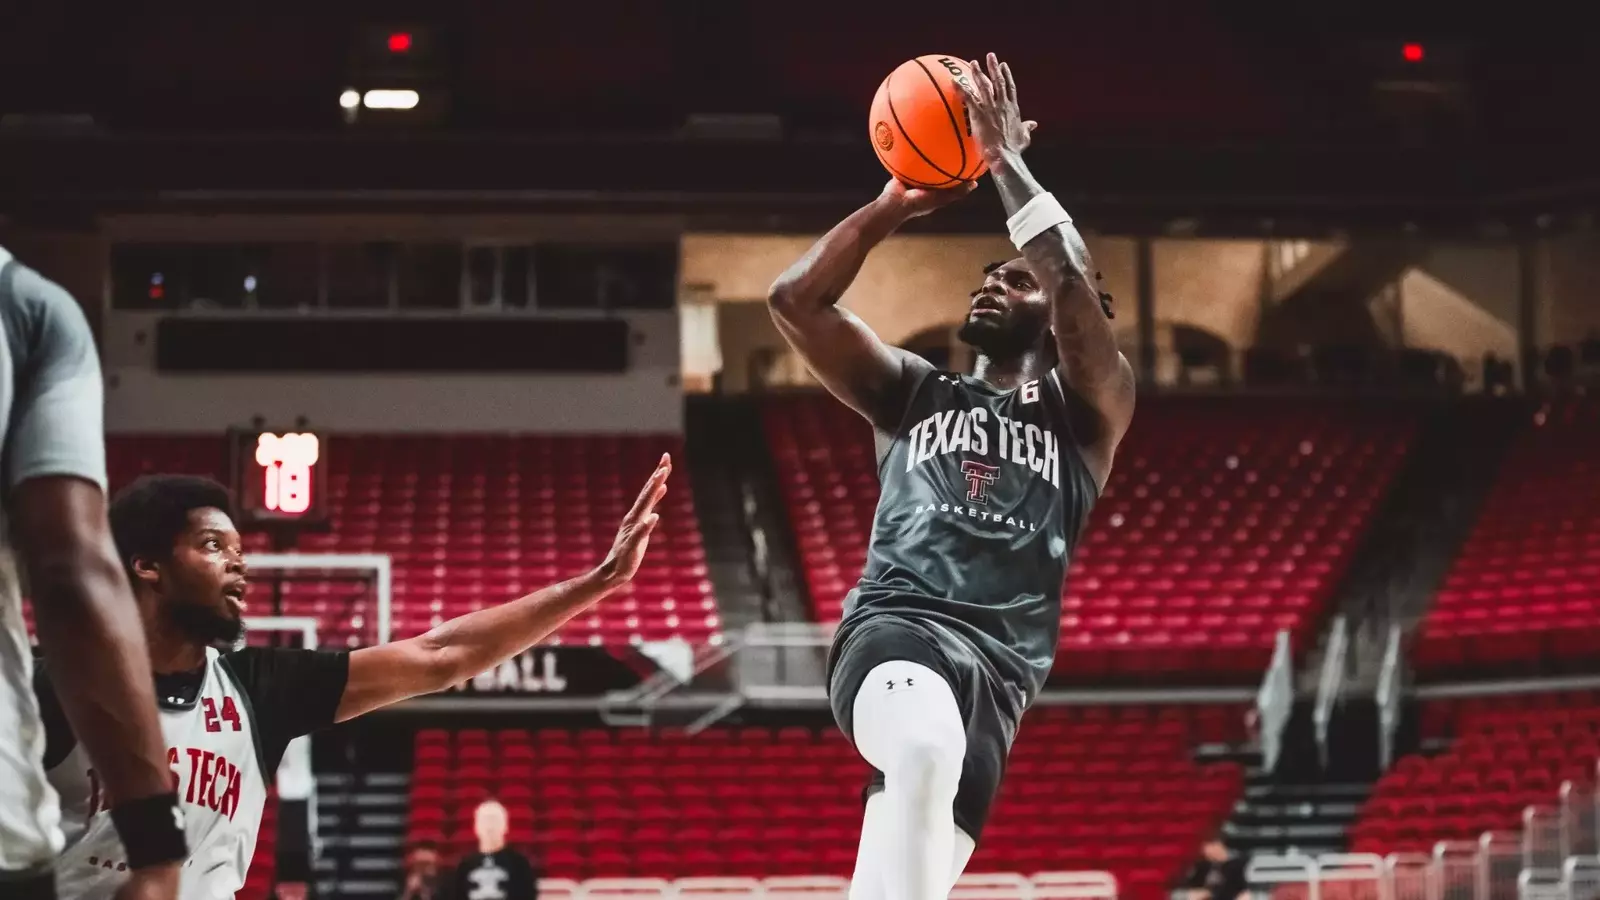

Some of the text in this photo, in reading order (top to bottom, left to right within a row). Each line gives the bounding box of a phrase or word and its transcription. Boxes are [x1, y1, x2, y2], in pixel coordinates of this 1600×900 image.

[1021, 379, 1039, 404] 6
[906, 407, 1059, 489] TEXAS TECH
[915, 503, 1036, 532] BASKETBALL
[202, 696, 242, 732] 24
[186, 748, 241, 823] TECH
